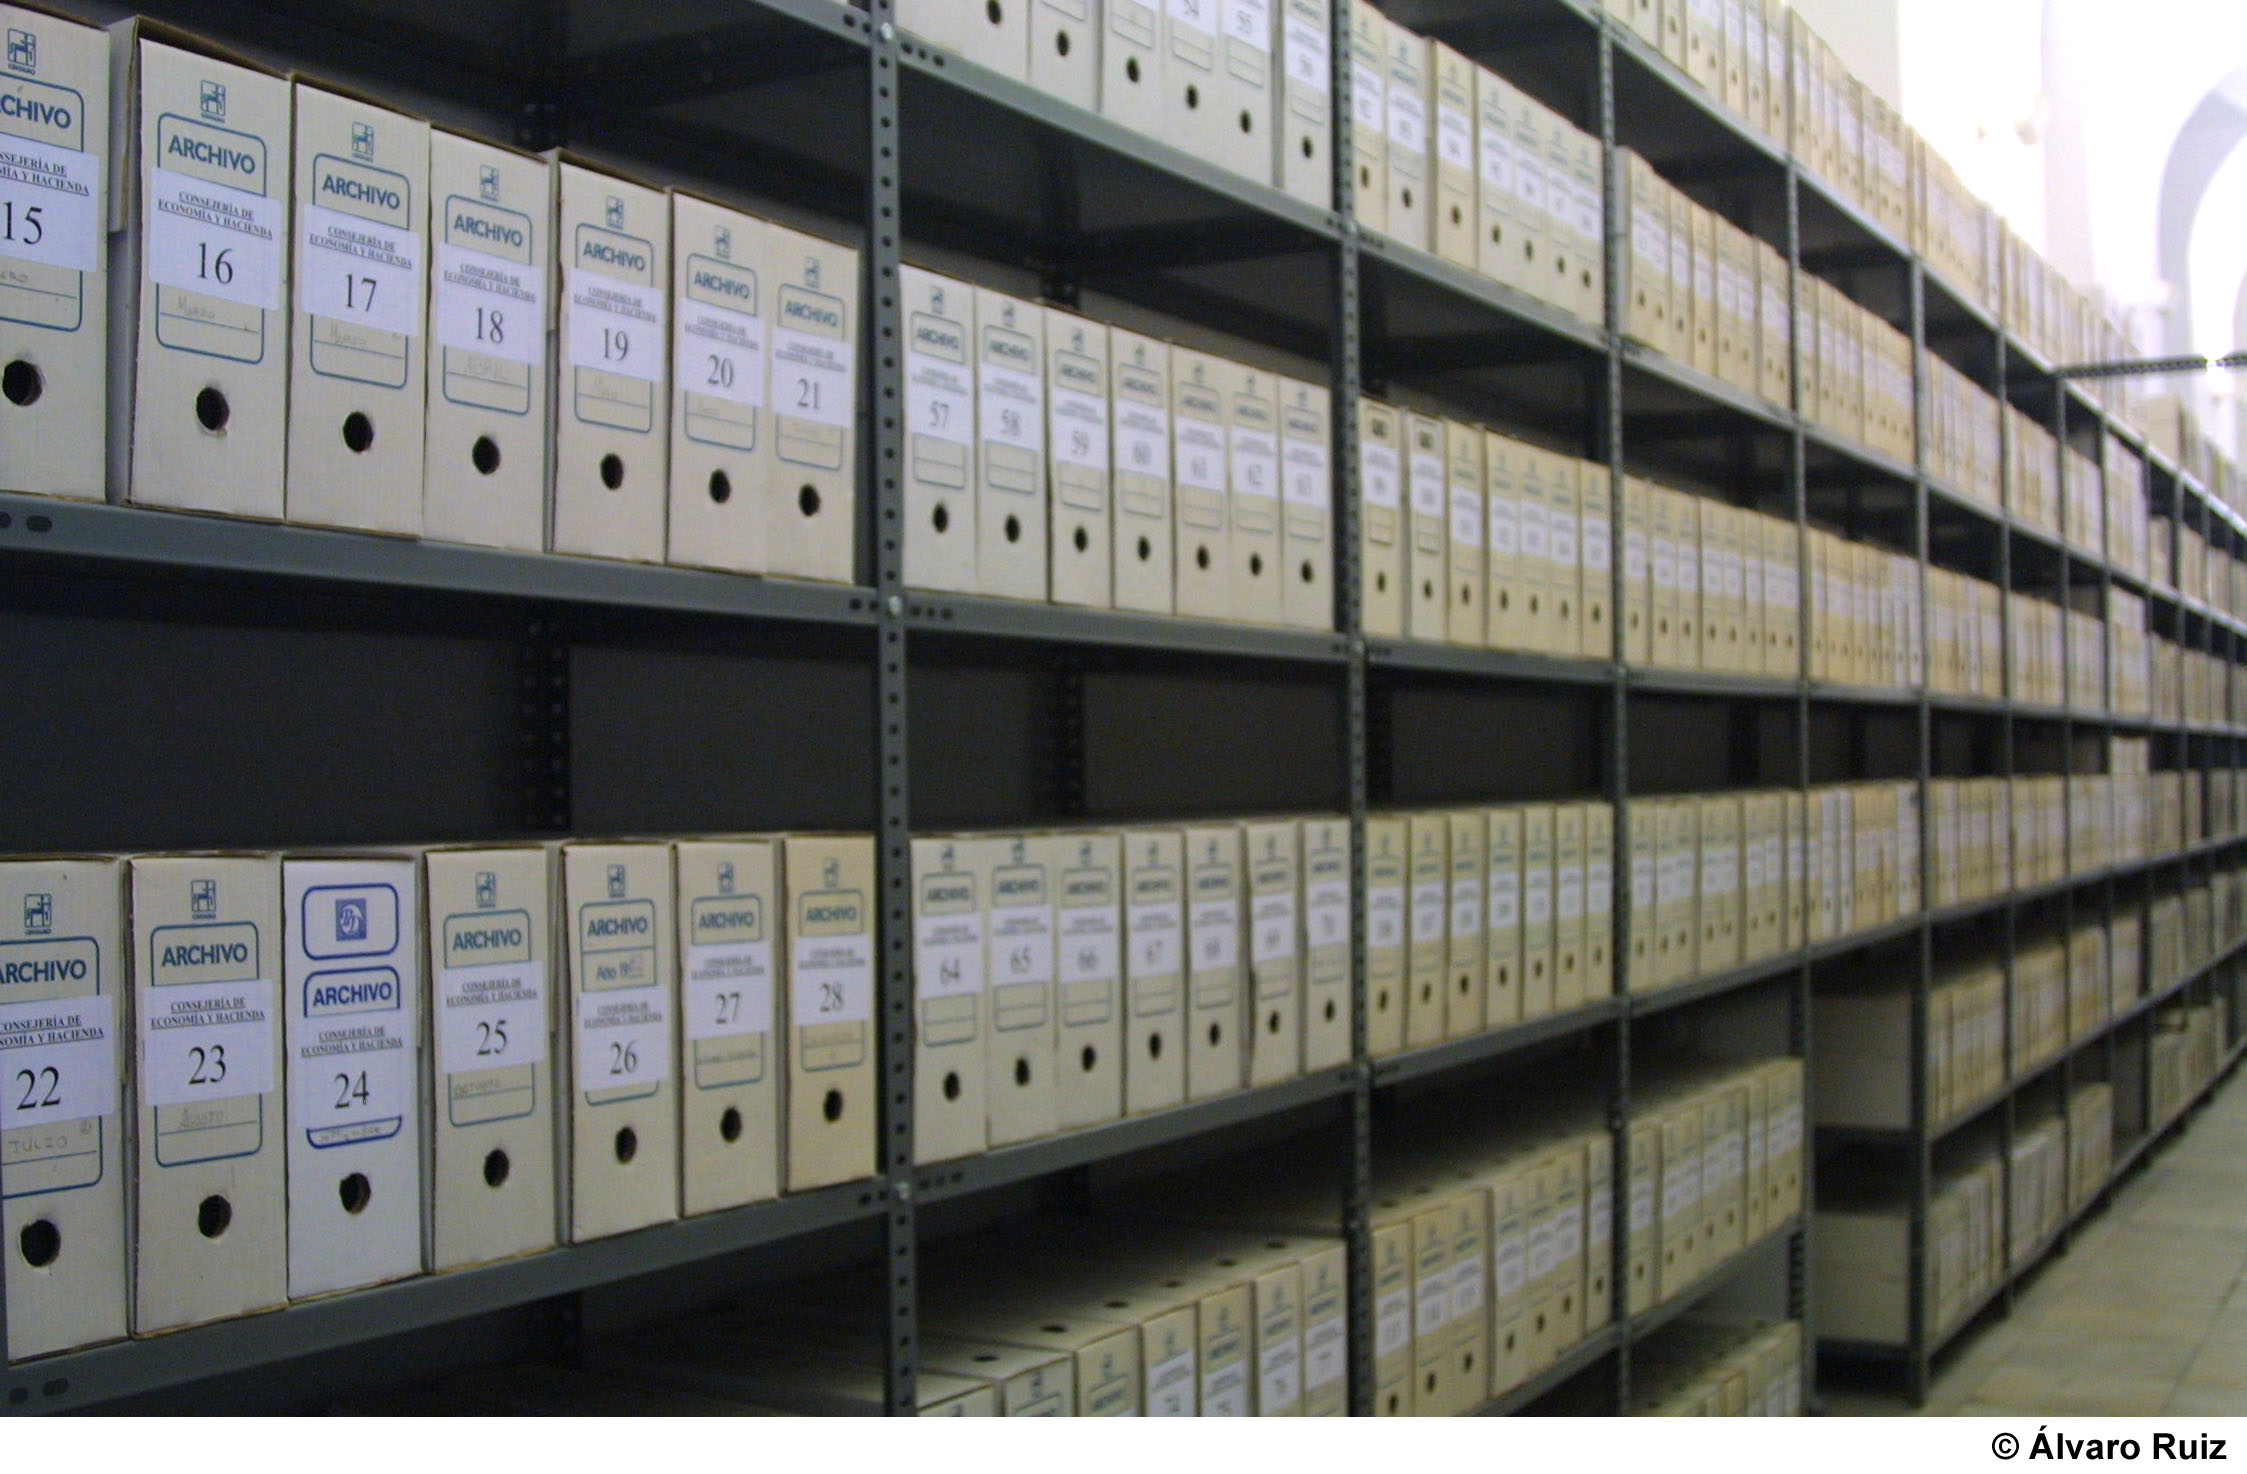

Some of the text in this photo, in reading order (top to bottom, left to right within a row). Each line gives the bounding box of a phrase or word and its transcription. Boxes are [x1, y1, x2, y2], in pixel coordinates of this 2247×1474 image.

[0, 93, 71, 130] CHIVO
[53, 162, 67, 176] DE
[168, 135, 255, 174] ARCHIVO
[32, 173, 90, 195] HACIENDA
[322, 173, 400, 210] ARCHIVO
[158, 198, 212, 221] ECONOMÍA
[224, 217, 272, 239] HACIENDA
[179, 191, 254, 219] CONSEJERÍA DE
[4, 201, 43, 245] 15
[327, 226, 396, 252] CONSEJERÍA DE
[453, 213, 523, 248] ARCHIVO
[198, 242, 233, 285] 16
[309, 233, 358, 256] ECONOMÍA
[368, 250, 412, 269] HACIENDA
[583, 241, 646, 272] ARCHIVO
[345, 273, 377, 312] 17
[694, 271, 750, 300] ARCHIVO
[476, 307, 504, 344] 18
[785, 300, 839, 327] ARCHIVO
[603, 327, 629, 361] 19
[707, 354, 734, 388] 20
[797, 378, 821, 411] 21
[930, 400, 950, 429] 57
[587, 916, 648, 937] ARCHIVO
[699, 912, 754, 929] ARCHIVO
[805, 906, 857, 922] ARCHIVO
[161, 942, 248, 967] ARCHIVO
[453, 928, 522, 950] ARCHIVO
[939, 956, 961, 986] 64
[1010, 943, 1032, 975] 65
[171, 995, 246, 1013] CONSEJERÍA DE
[313, 981, 392, 1007] ARCHIVO
[715, 991, 741, 1025] 27
[818, 981, 844, 1013] 28
[48, 1028, 104, 1043] HACIENDA
[67, 1015, 82, 1026] DE
[151, 1012, 205, 1029] ECONOMÍA
[216, 1010, 265, 1023] HACIENDA
[374, 1025, 385, 1037] DE
[476, 1019, 507, 1056] 25
[188, 1044, 226, 1086] 23
[609, 1039, 638, 1075] 26
[16, 1065, 61, 1110] 22
[334, 1069, 370, 1109] 24
